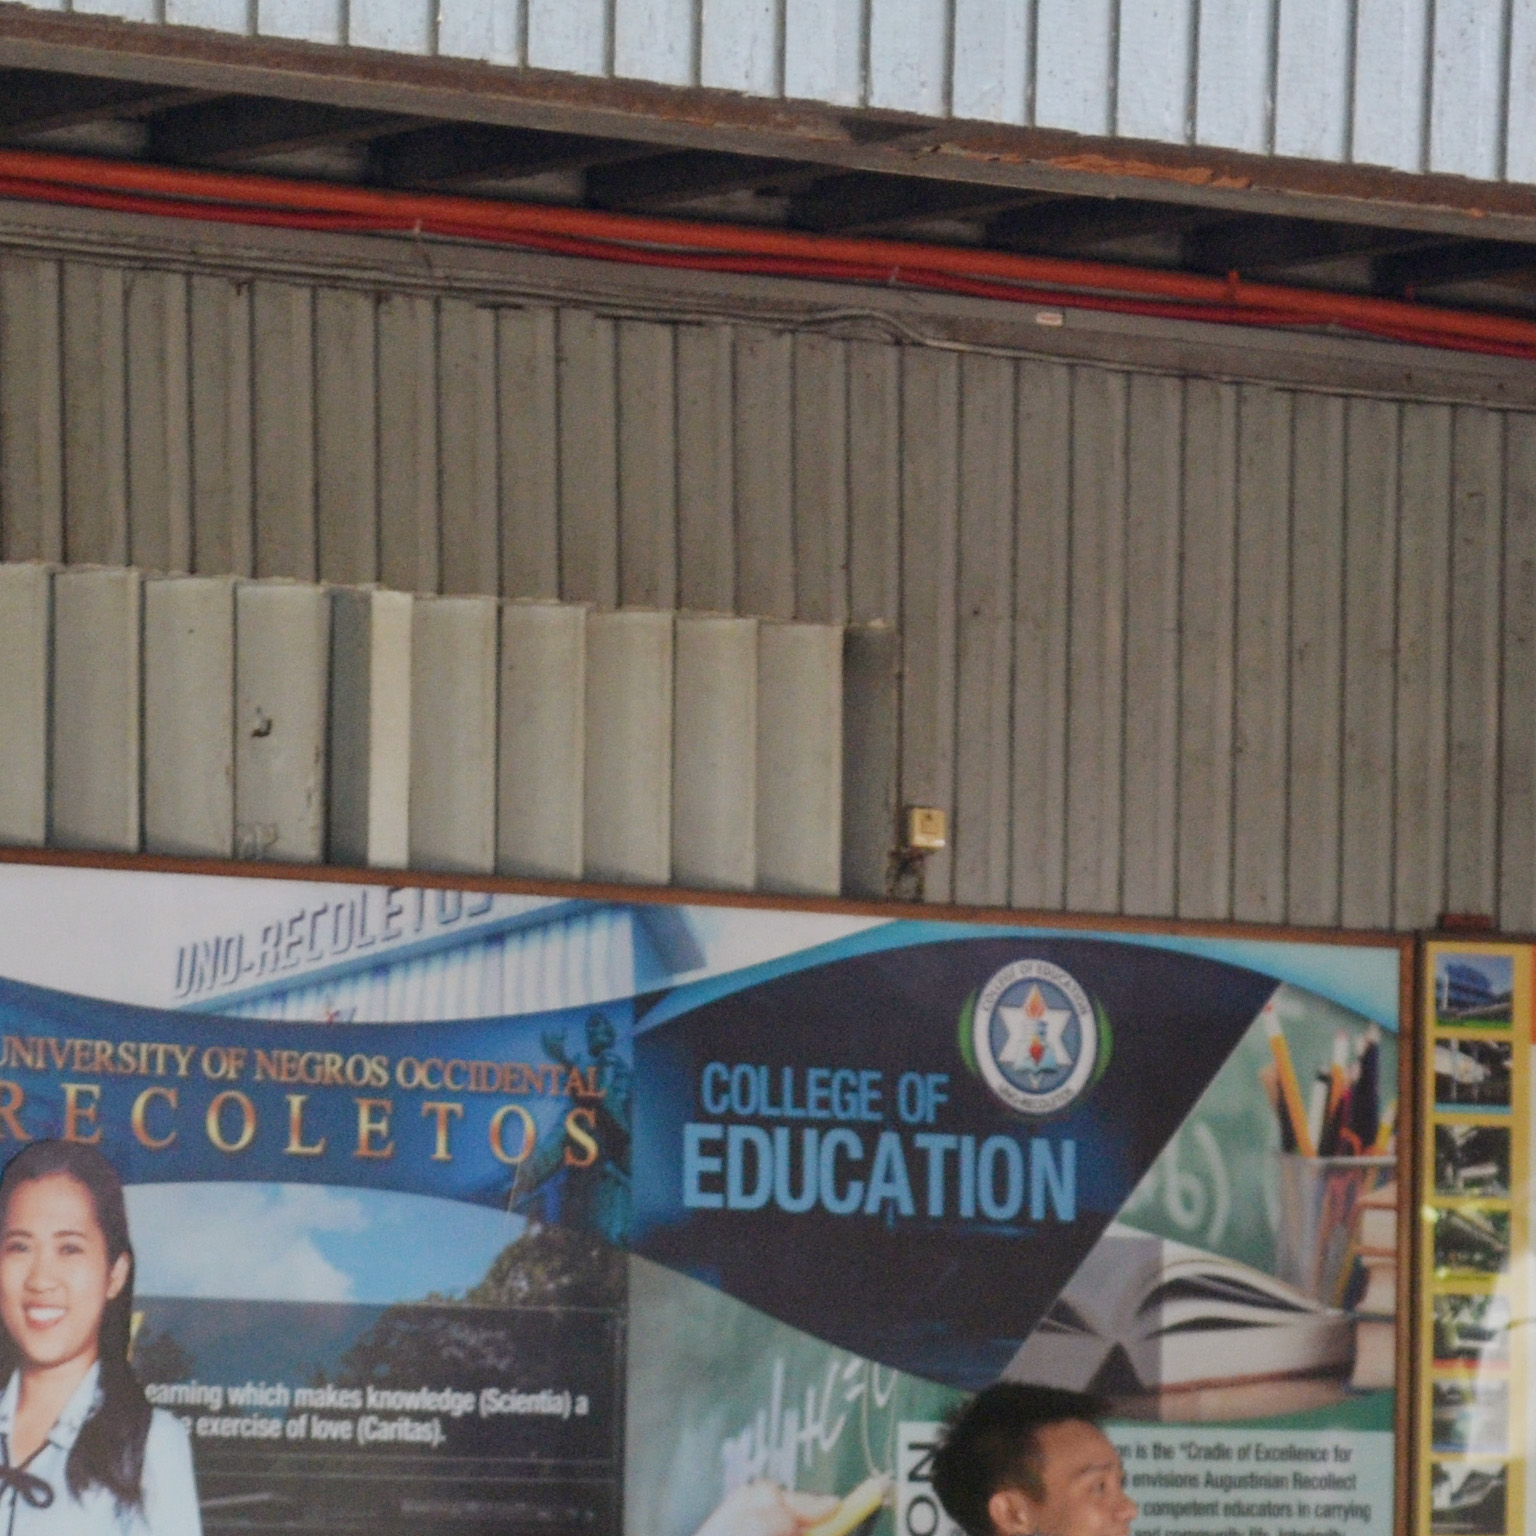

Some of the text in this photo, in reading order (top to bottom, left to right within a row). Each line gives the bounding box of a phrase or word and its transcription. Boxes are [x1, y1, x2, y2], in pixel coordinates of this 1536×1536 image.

[201, 1047, 248, 1081] OF
[254, 1049, 389, 1088] NEGROS
[396, 1057, 607, 1099] OCCIDENTAL
[701, 1062, 951, 1124] COLLEGE OF
[683, 1122, 1078, 1223] EDUCATION
[144, 1381, 222, 1408] earning
[228, 1381, 289, 1408] which
[294, 1384, 362, 1408] makes
[367, 1384, 475, 1417] knowledge
[197, 1414, 281, 1438] exercise
[286, 1415, 309, 1439] of
[312, 1416, 352, 1440] love
[1152, 1443, 1175, 1459] the
[1255, 1443, 1329, 1463] Excellence
[1204, 1471, 1288, 1492] Augustinian
[1292, 1472, 1356, 1491] Recollect
